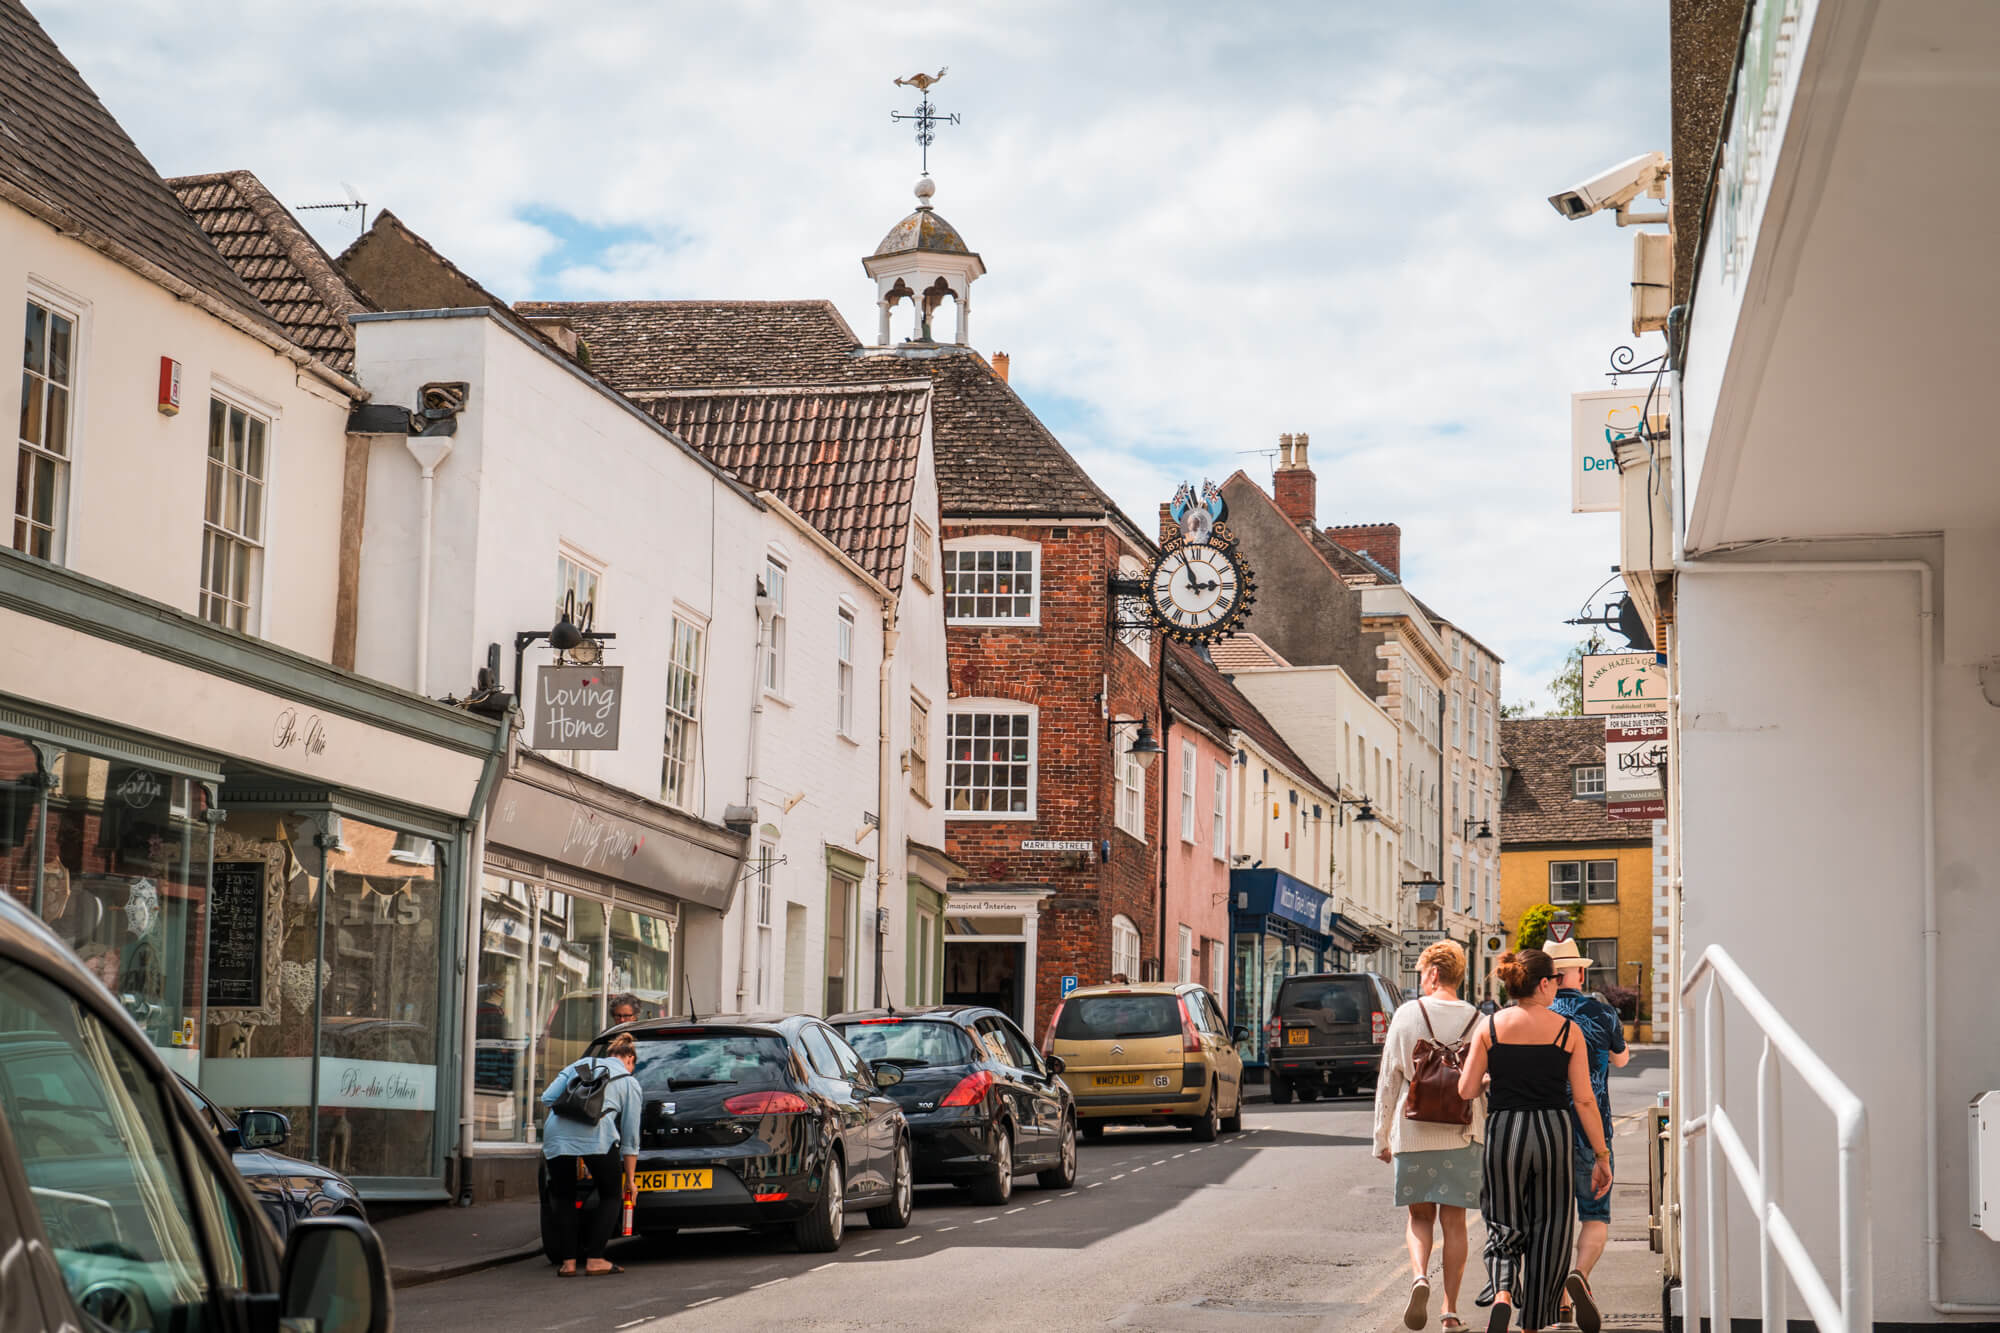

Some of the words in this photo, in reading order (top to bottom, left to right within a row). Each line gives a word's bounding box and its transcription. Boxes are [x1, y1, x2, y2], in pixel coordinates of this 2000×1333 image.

[1209, 537, 1229, 550] 1897
[1588, 666, 1608, 688] MARK
[544, 676, 615, 719] Loving
[546, 707, 609, 743] Home
[1621, 728, 1640, 737] For
[1640, 726, 1664, 735] Sale
[1023, 841, 1056, 849] MARKET
[1058, 842, 1091, 850] STREET
[945, 902, 982, 911] Imagined
[1065, 978, 1075, 990] P
[1120, 1074, 1141, 1084] LUP
[1155, 1076, 1168, 1086] GB
[643, 1127, 693, 1135] LEON
[633, 1174, 667, 1189] CK61
[672, 1173, 702, 1187] TYX
